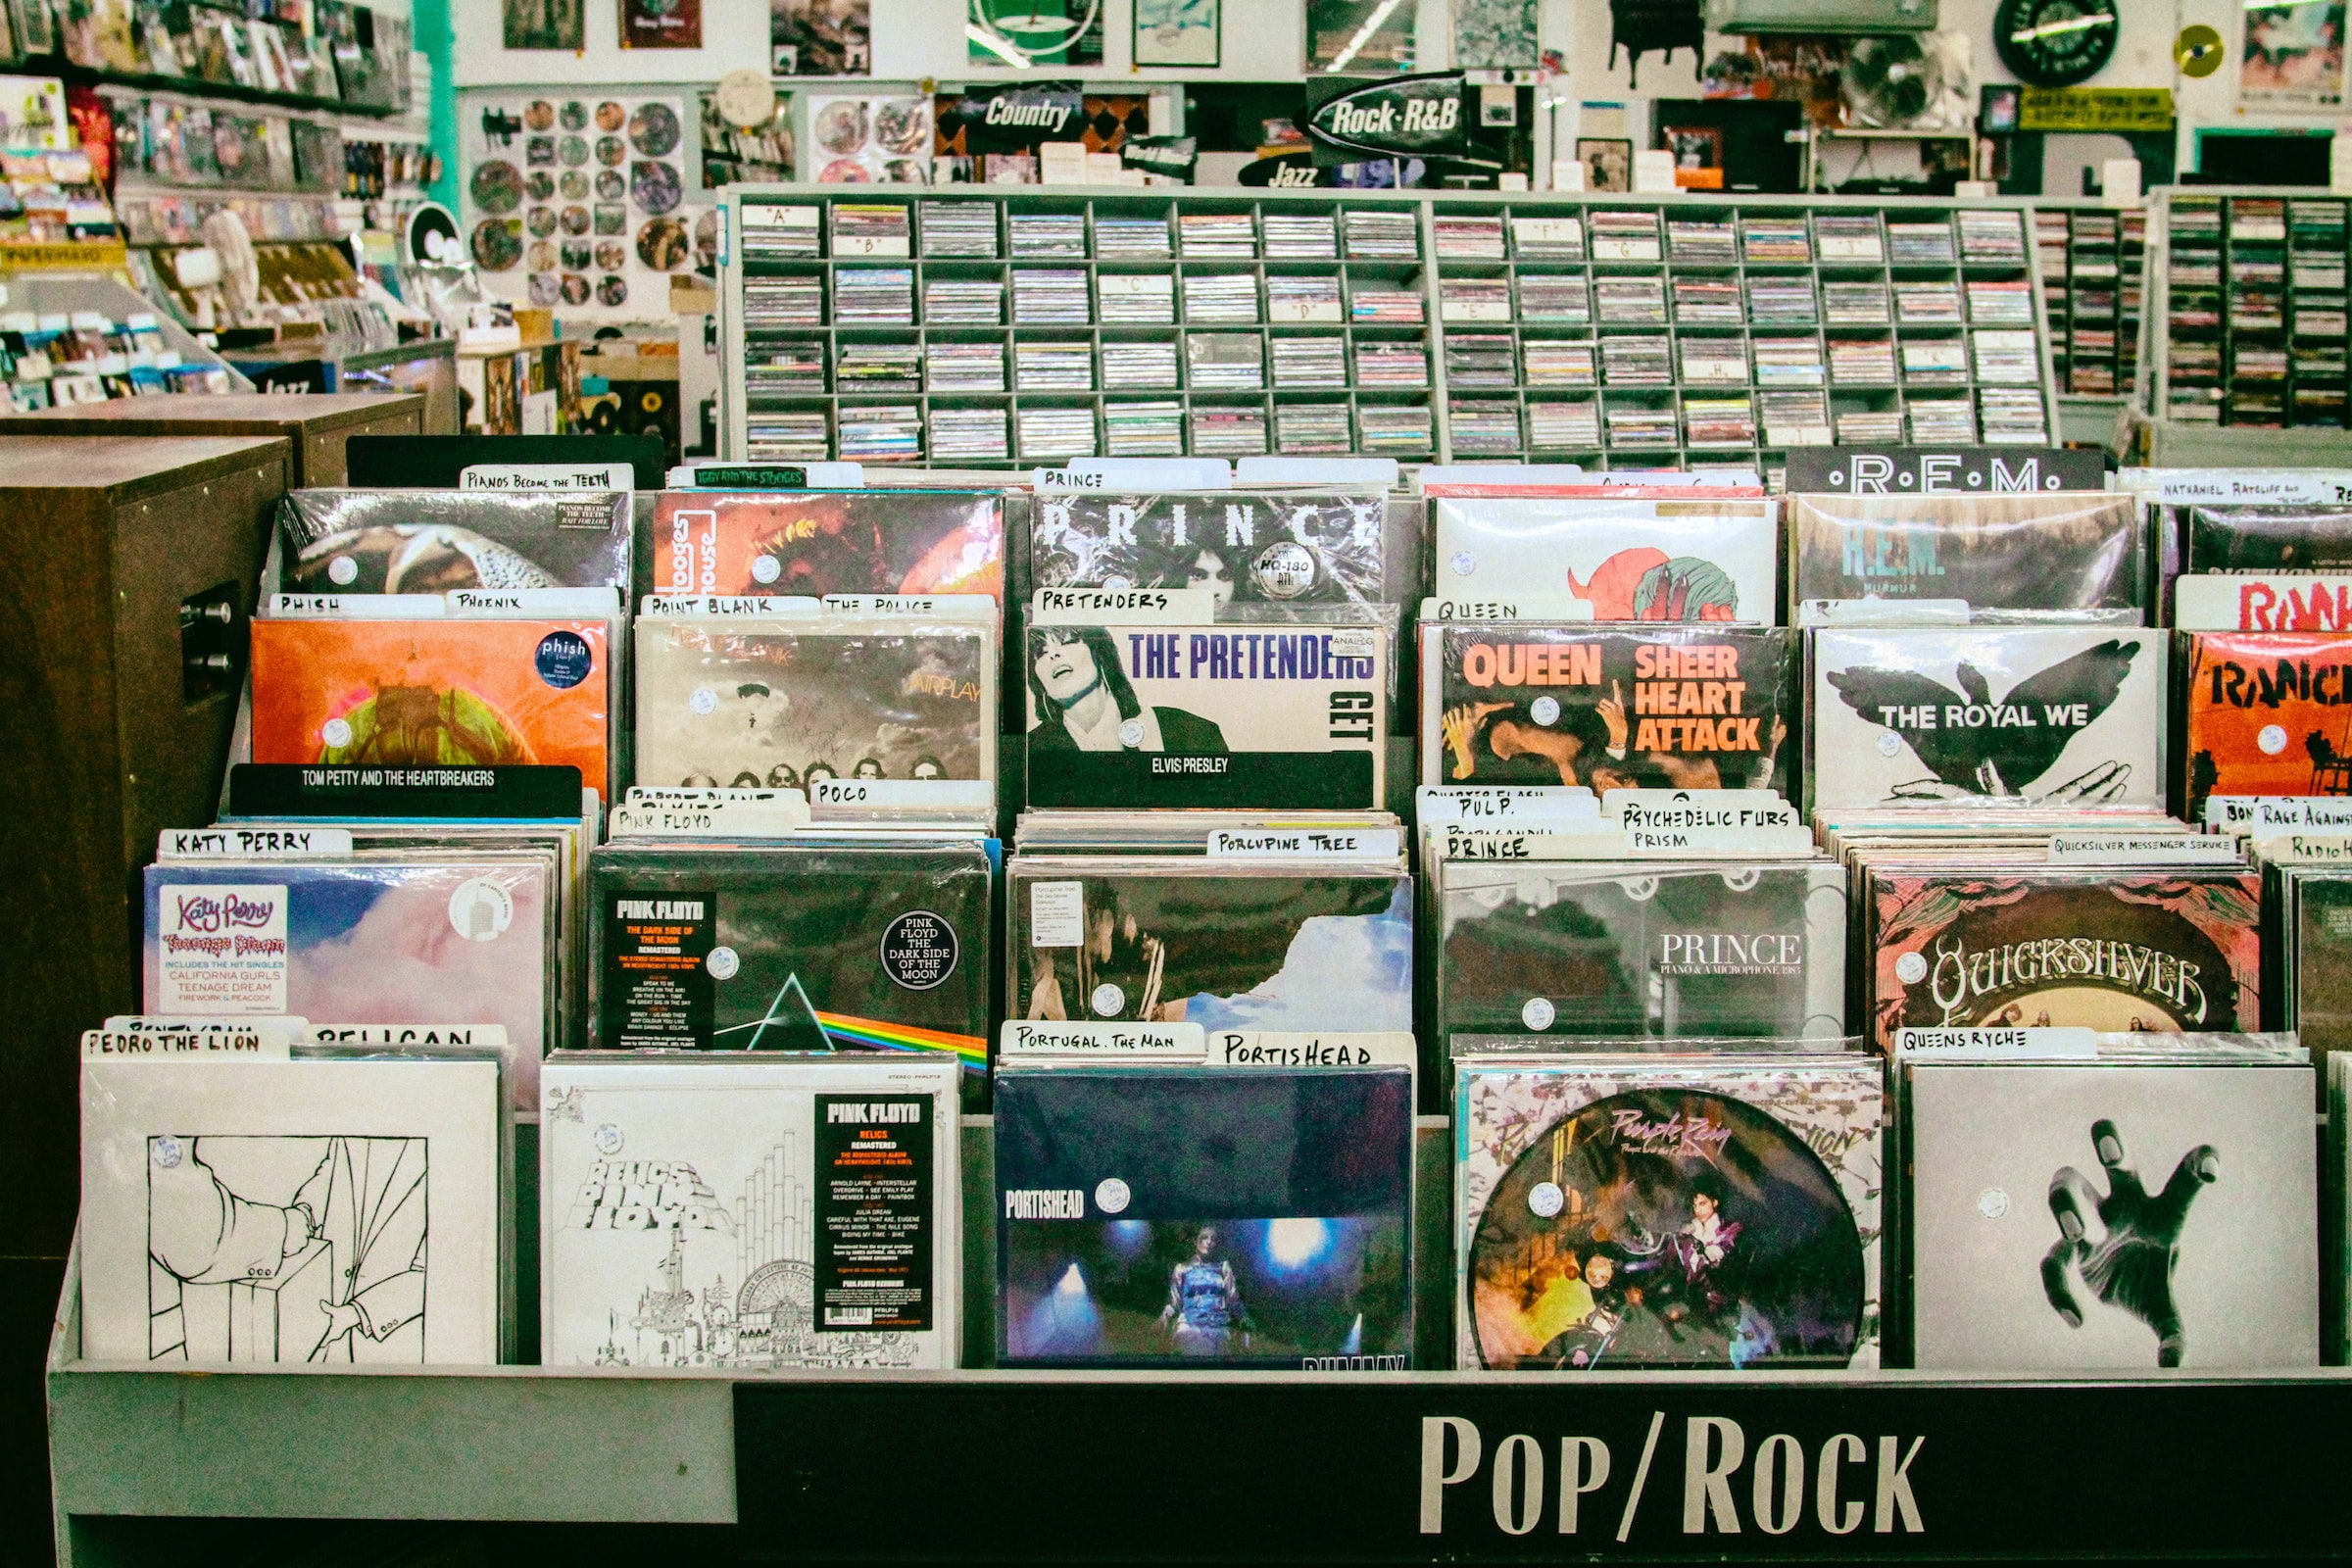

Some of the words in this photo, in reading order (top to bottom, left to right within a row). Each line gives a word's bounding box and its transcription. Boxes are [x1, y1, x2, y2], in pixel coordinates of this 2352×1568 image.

[986, 97, 1071, 132] Country
[1268, 162, 1318, 187] Jazz
[467, 472, 509, 489] PIANOS
[514, 474, 550, 488] BECOME
[554, 478, 568, 488] THE
[699, 471, 718, 483] IGGY
[721, 471, 739, 482] AND
[741, 470, 758, 481] THE
[760, 471, 803, 484] STOOGES
[1046, 471, 1102, 488] PRINCE
[1043, 504, 1383, 547] PRINCE
[1260, 560, 1309, 571] HQ-180
[1864, 583, 1917, 594] MURMUR
[458, 594, 521, 610] PHOENIX
[652, 598, 697, 615] POINT
[709, 598, 772, 615] BLANK
[1043, 591, 1168, 611] PRETENDERS
[1438, 601, 1517, 620] QUEEN
[542, 638, 586, 656] phish
[1128, 634, 1180, 679] THE
[1463, 643, 1601, 688] QUEEN
[1635, 645, 1739, 679] SHEER
[911, 671, 982, 702] AIRPLAY
[1635, 682, 1745, 715] HEART
[1330, 691, 1374, 742] GET
[1879, 705, 1936, 729] THE
[1945, 704, 2037, 728] ROYAL
[2043, 703, 2089, 726] WE
[1635, 718, 1761, 752] ATTACK
[1152, 758, 1182, 774] ELVIS
[1183, 758, 1228, 774] PRESLEY
[303, 769, 324, 786] TOM
[326, 769, 359, 787] PETTY
[361, 769, 383, 787] AND
[384, 769, 405, 787] THE
[407, 769, 495, 787] HEARTBREAKERS
[819, 783, 866, 803] POCO
[619, 810, 653, 832] PINK
[664, 813, 711, 830] FLOYD
[1623, 809, 1734, 830] PSYCHEDELIC
[1740, 808, 1789, 827] FURS
[2261, 805, 2298, 824] RAGE
[175, 833, 226, 853] KATY
[237, 832, 311, 853] PERRY
[1219, 833, 1299, 852] PORCUPINE
[1308, 834, 1358, 851] TREE
[1448, 837, 1529, 858] PRINCE
[1635, 832, 1688, 848] PRISM
[2055, 838, 2125, 854] QUICKSILVER
[2130, 841, 2186, 851] MESSENGER
[2190, 840, 2230, 851] SERVICE
[177, 895, 220, 932] Katy
[222, 893, 274, 928] Perry
[616, 901, 656, 919] PINK
[657, 901, 704, 920] FLOYD
[643, 926, 662, 935] DARK
[664, 926, 681, 935] SIDE
[906, 918, 933, 928] PINK
[900, 928, 939, 938] FLOYD
[907, 939, 931, 948] THE
[1660, 934, 1801, 964] PRINCE
[889, 950, 920, 958] DARK
[922, 949, 950, 958] SIDE
[899, 959, 915, 968] OF
[917, 959, 941, 968] THE
[1661, 965, 1692, 974] PIANO
[1713, 965, 1780, 974] MICROPHONE
[170, 971, 237, 980] CALIFORNIA
[240, 971, 281, 980] GURLS
[902, 969, 938, 979] MOON
[1932, 936, 2208, 1027] QUICKSILVER
[178, 983, 229, 992] TEENAGE
[232, 983, 272, 992] DREAM
[90, 1033, 152, 1054] PEDRO
[158, 1034, 199, 1052] THE
[209, 1035, 259, 1052] LION
[1112, 1034, 1137, 1049] THE
[1142, 1034, 1174, 1049] MAN
[1224, 1034, 1371, 1065] PORTISHEAD
[1904, 1031, 1966, 1051] QUEENS
[1972, 1031, 2027, 1049] RYCHE
[827, 1102, 869, 1123] PINK
[869, 1102, 920, 1123] FLOYD
[859, 1130, 888, 1139] RELICS
[1611, 1108, 1684, 1147] Purple
[1680, 1117, 1732, 1170] Rain
[1005, 1190, 1084, 1219] PORTISHEAD
